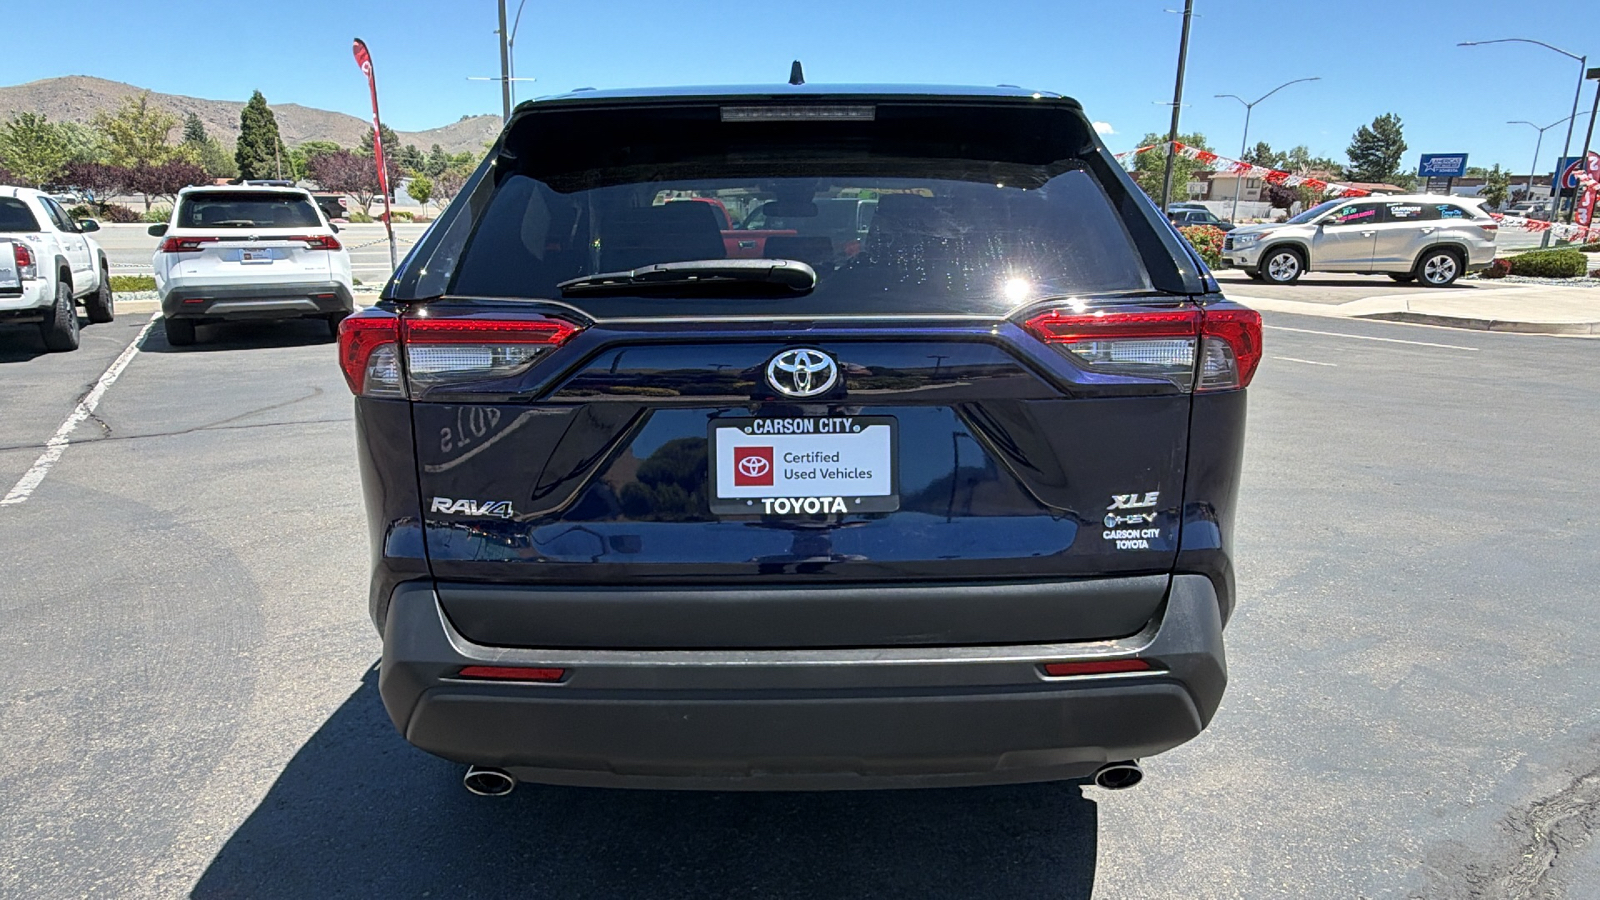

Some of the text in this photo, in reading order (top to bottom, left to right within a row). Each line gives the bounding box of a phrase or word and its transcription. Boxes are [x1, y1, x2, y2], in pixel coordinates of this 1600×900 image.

[753, 418, 853, 434] CARSON CITY
[783, 451, 840, 463] Certified
[784, 467, 873, 480] Used Vehicles
[430, 496, 514, 519] RAV4
[761, 497, 848, 515] TOYOTA
[1106, 491, 1160, 511] XLE
[1102, 528, 1160, 540] CARSON CITY
[1115, 540, 1149, 550] TOYOTA
